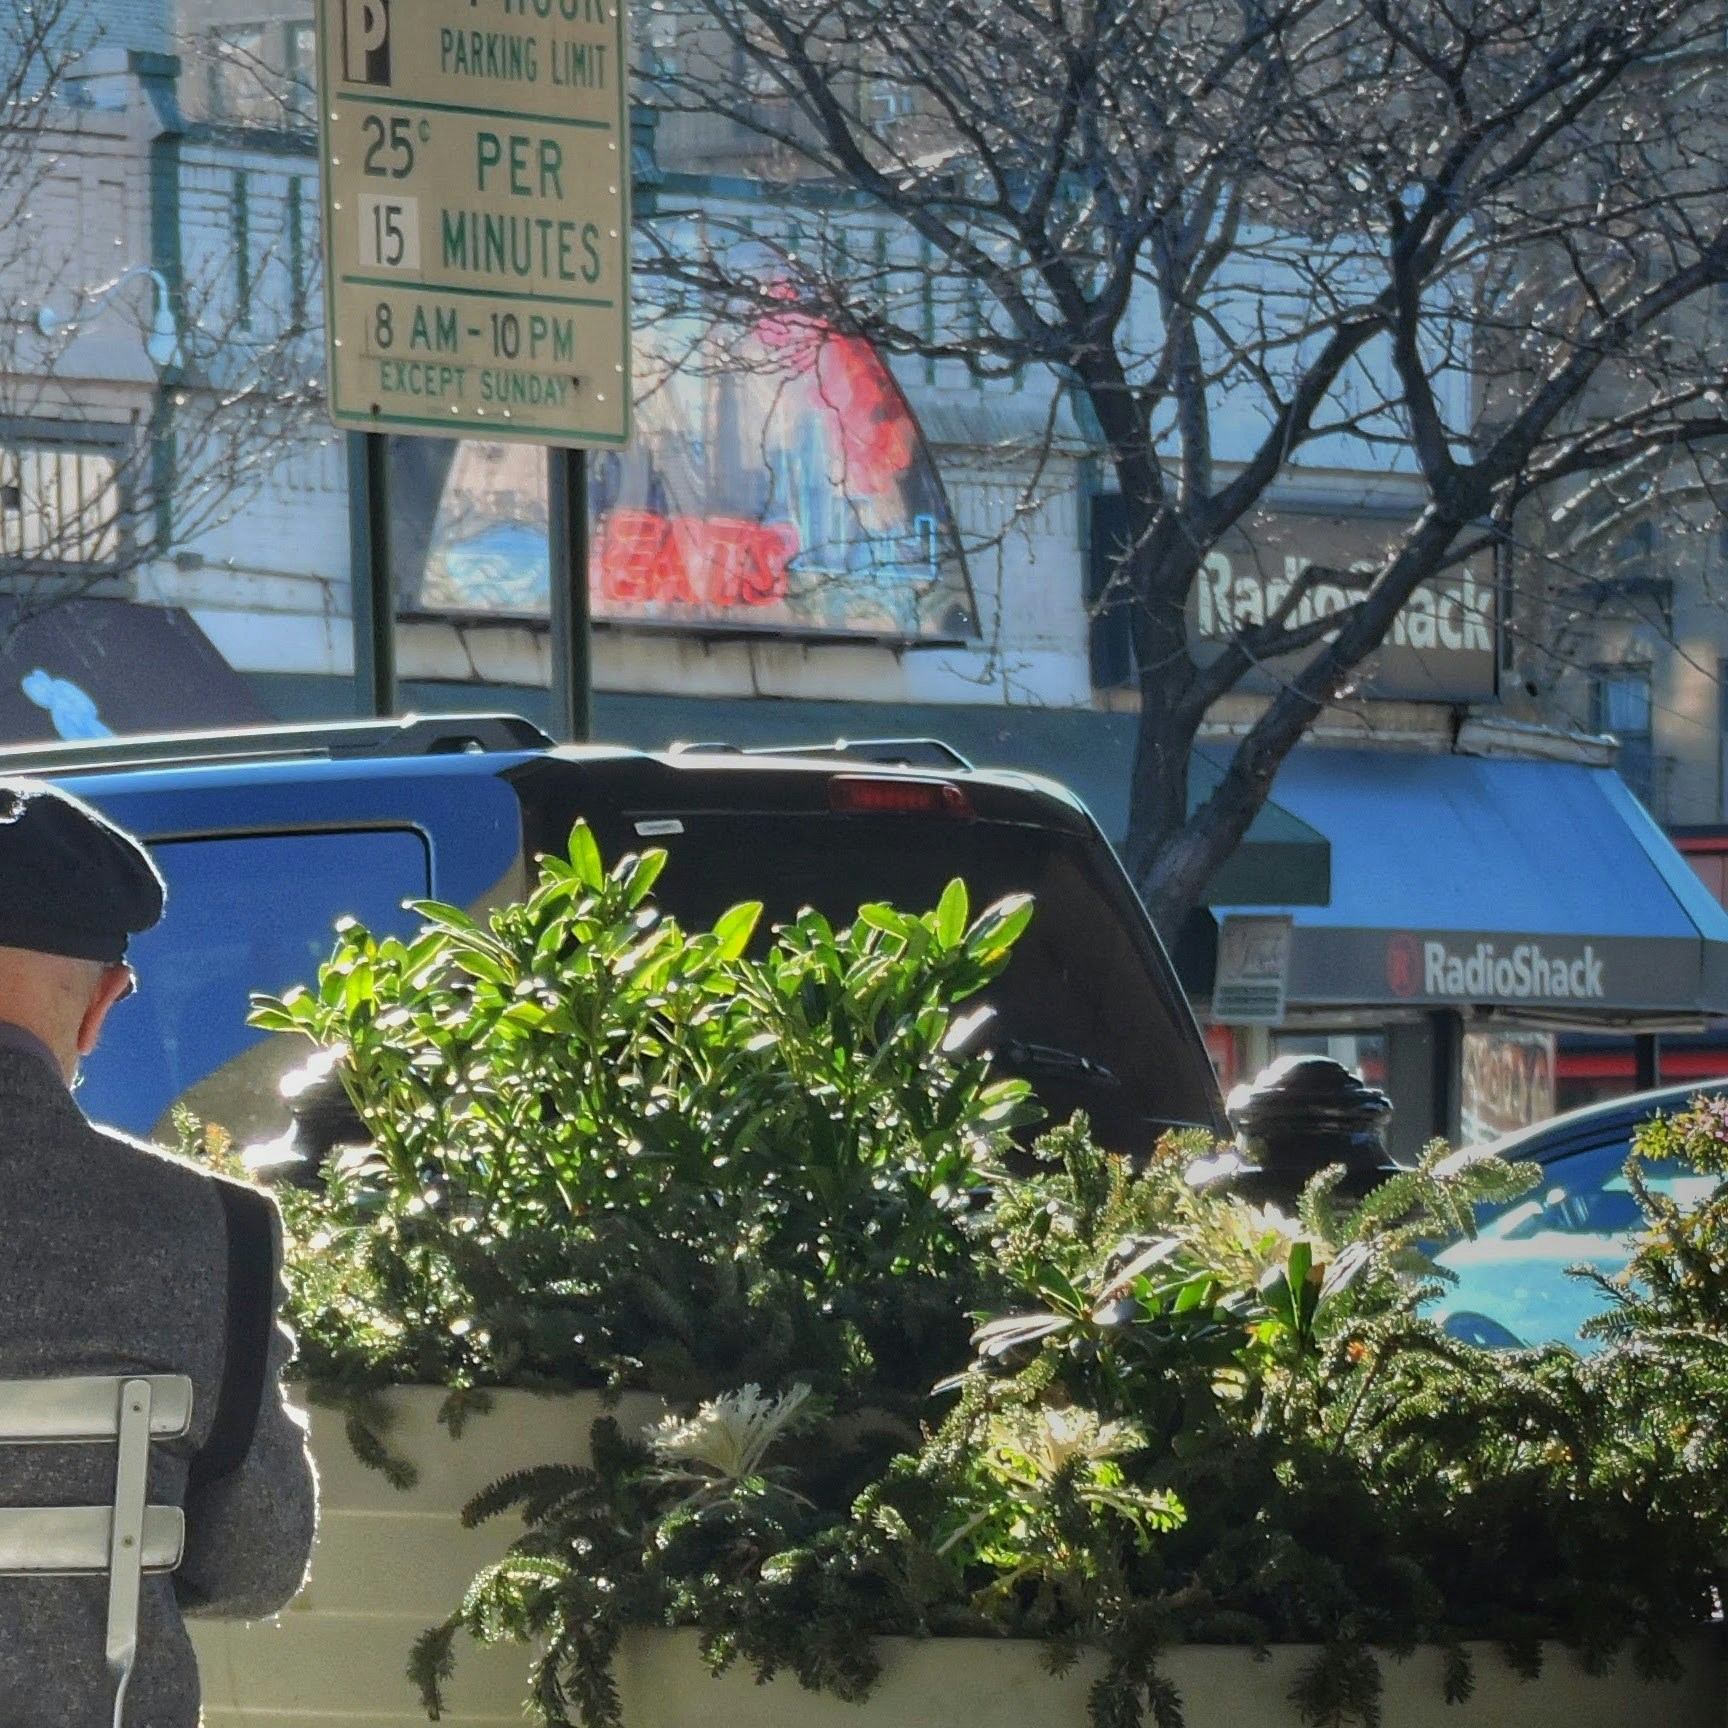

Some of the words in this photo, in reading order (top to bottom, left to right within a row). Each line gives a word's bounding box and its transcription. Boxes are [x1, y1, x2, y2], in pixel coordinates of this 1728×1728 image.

[345, 0, 388, 83] P
[440, 27, 537, 83] PARKING
[551, 39, 607, 89] LIMIT
[476, 131, 564, 200] PER
[373, 205, 404, 266] 15
[441, 208, 601, 284] MINUTES
[375, 302, 393, 349] 8
[380, 359, 466, 398] EXCEPT
[481, 368, 569, 407] SUNDAY
[1196, 550, 1493, 651] Radioack
[1424, 941, 1604, 998] RadioShack
